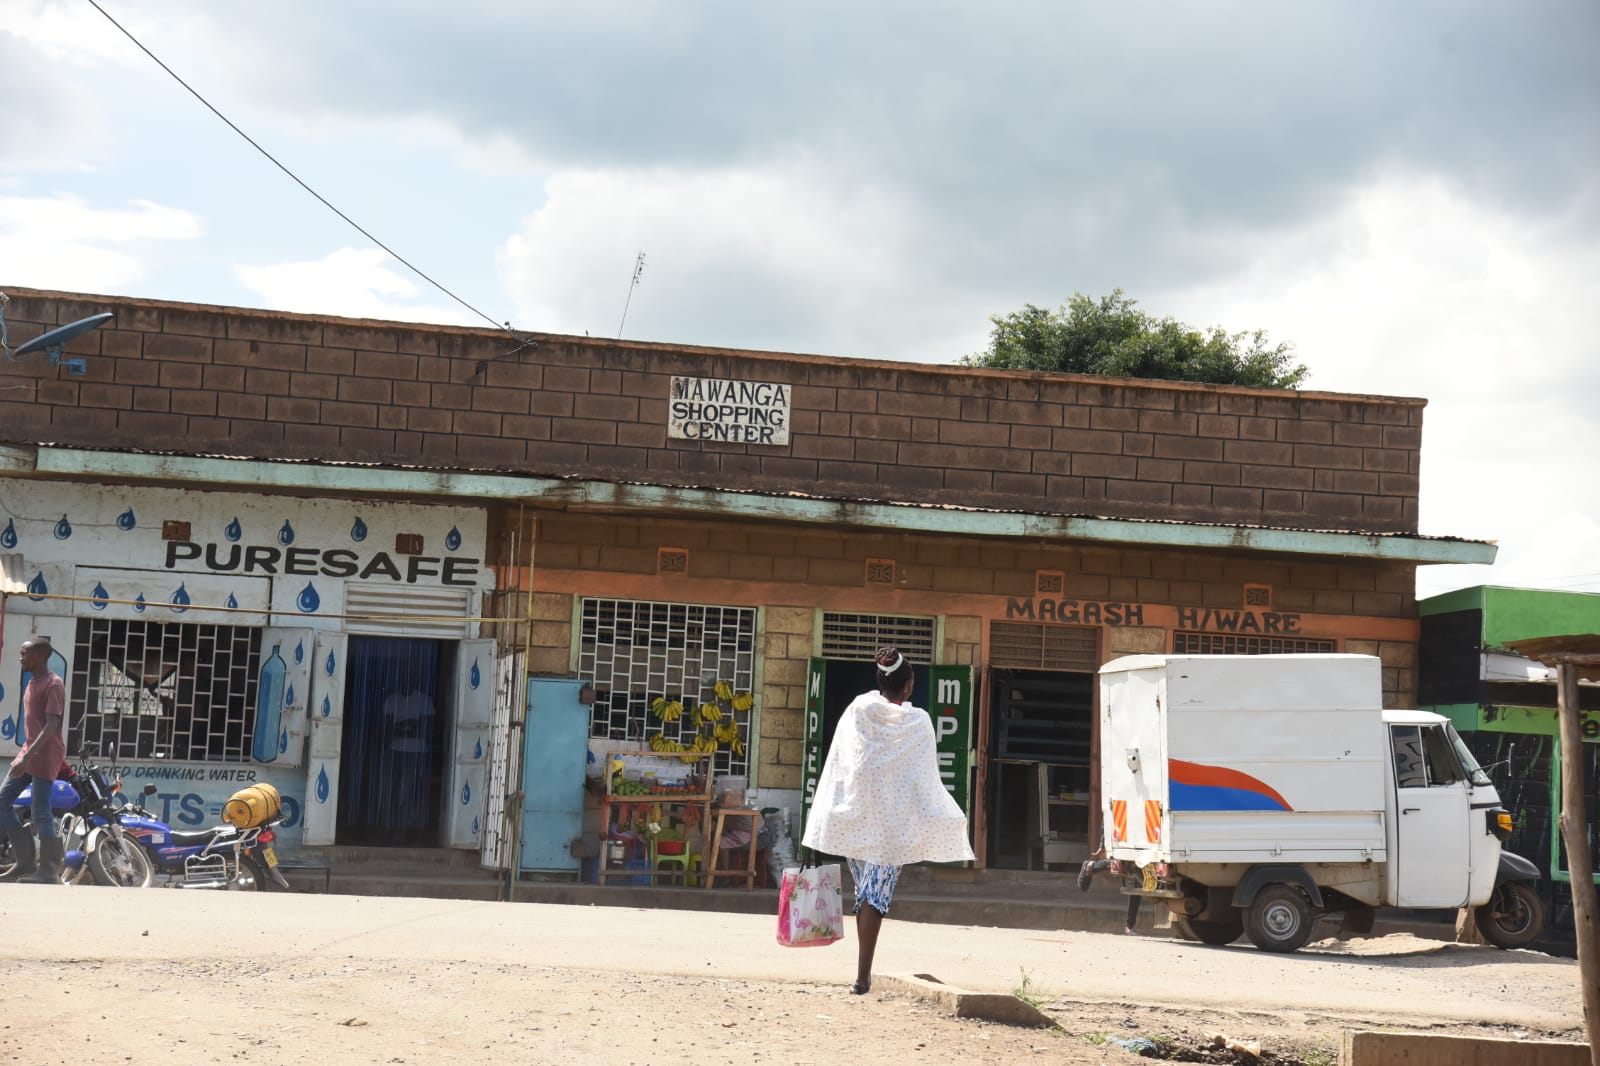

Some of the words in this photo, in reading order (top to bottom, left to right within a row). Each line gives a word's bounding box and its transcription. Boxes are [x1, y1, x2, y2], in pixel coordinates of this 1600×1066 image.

[673, 377, 787, 408] MAWANGA
[672, 402, 784, 426] SHOPPING
[683, 421, 775, 444] CENTER
[165, 541, 480, 586] PURESAFE
[1005, 596, 1144, 626] MAGASH
[1177, 607, 1302, 635] H/WARE
[135, 766, 205, 781] DRINKING
[208, 768, 257, 782] WATER
